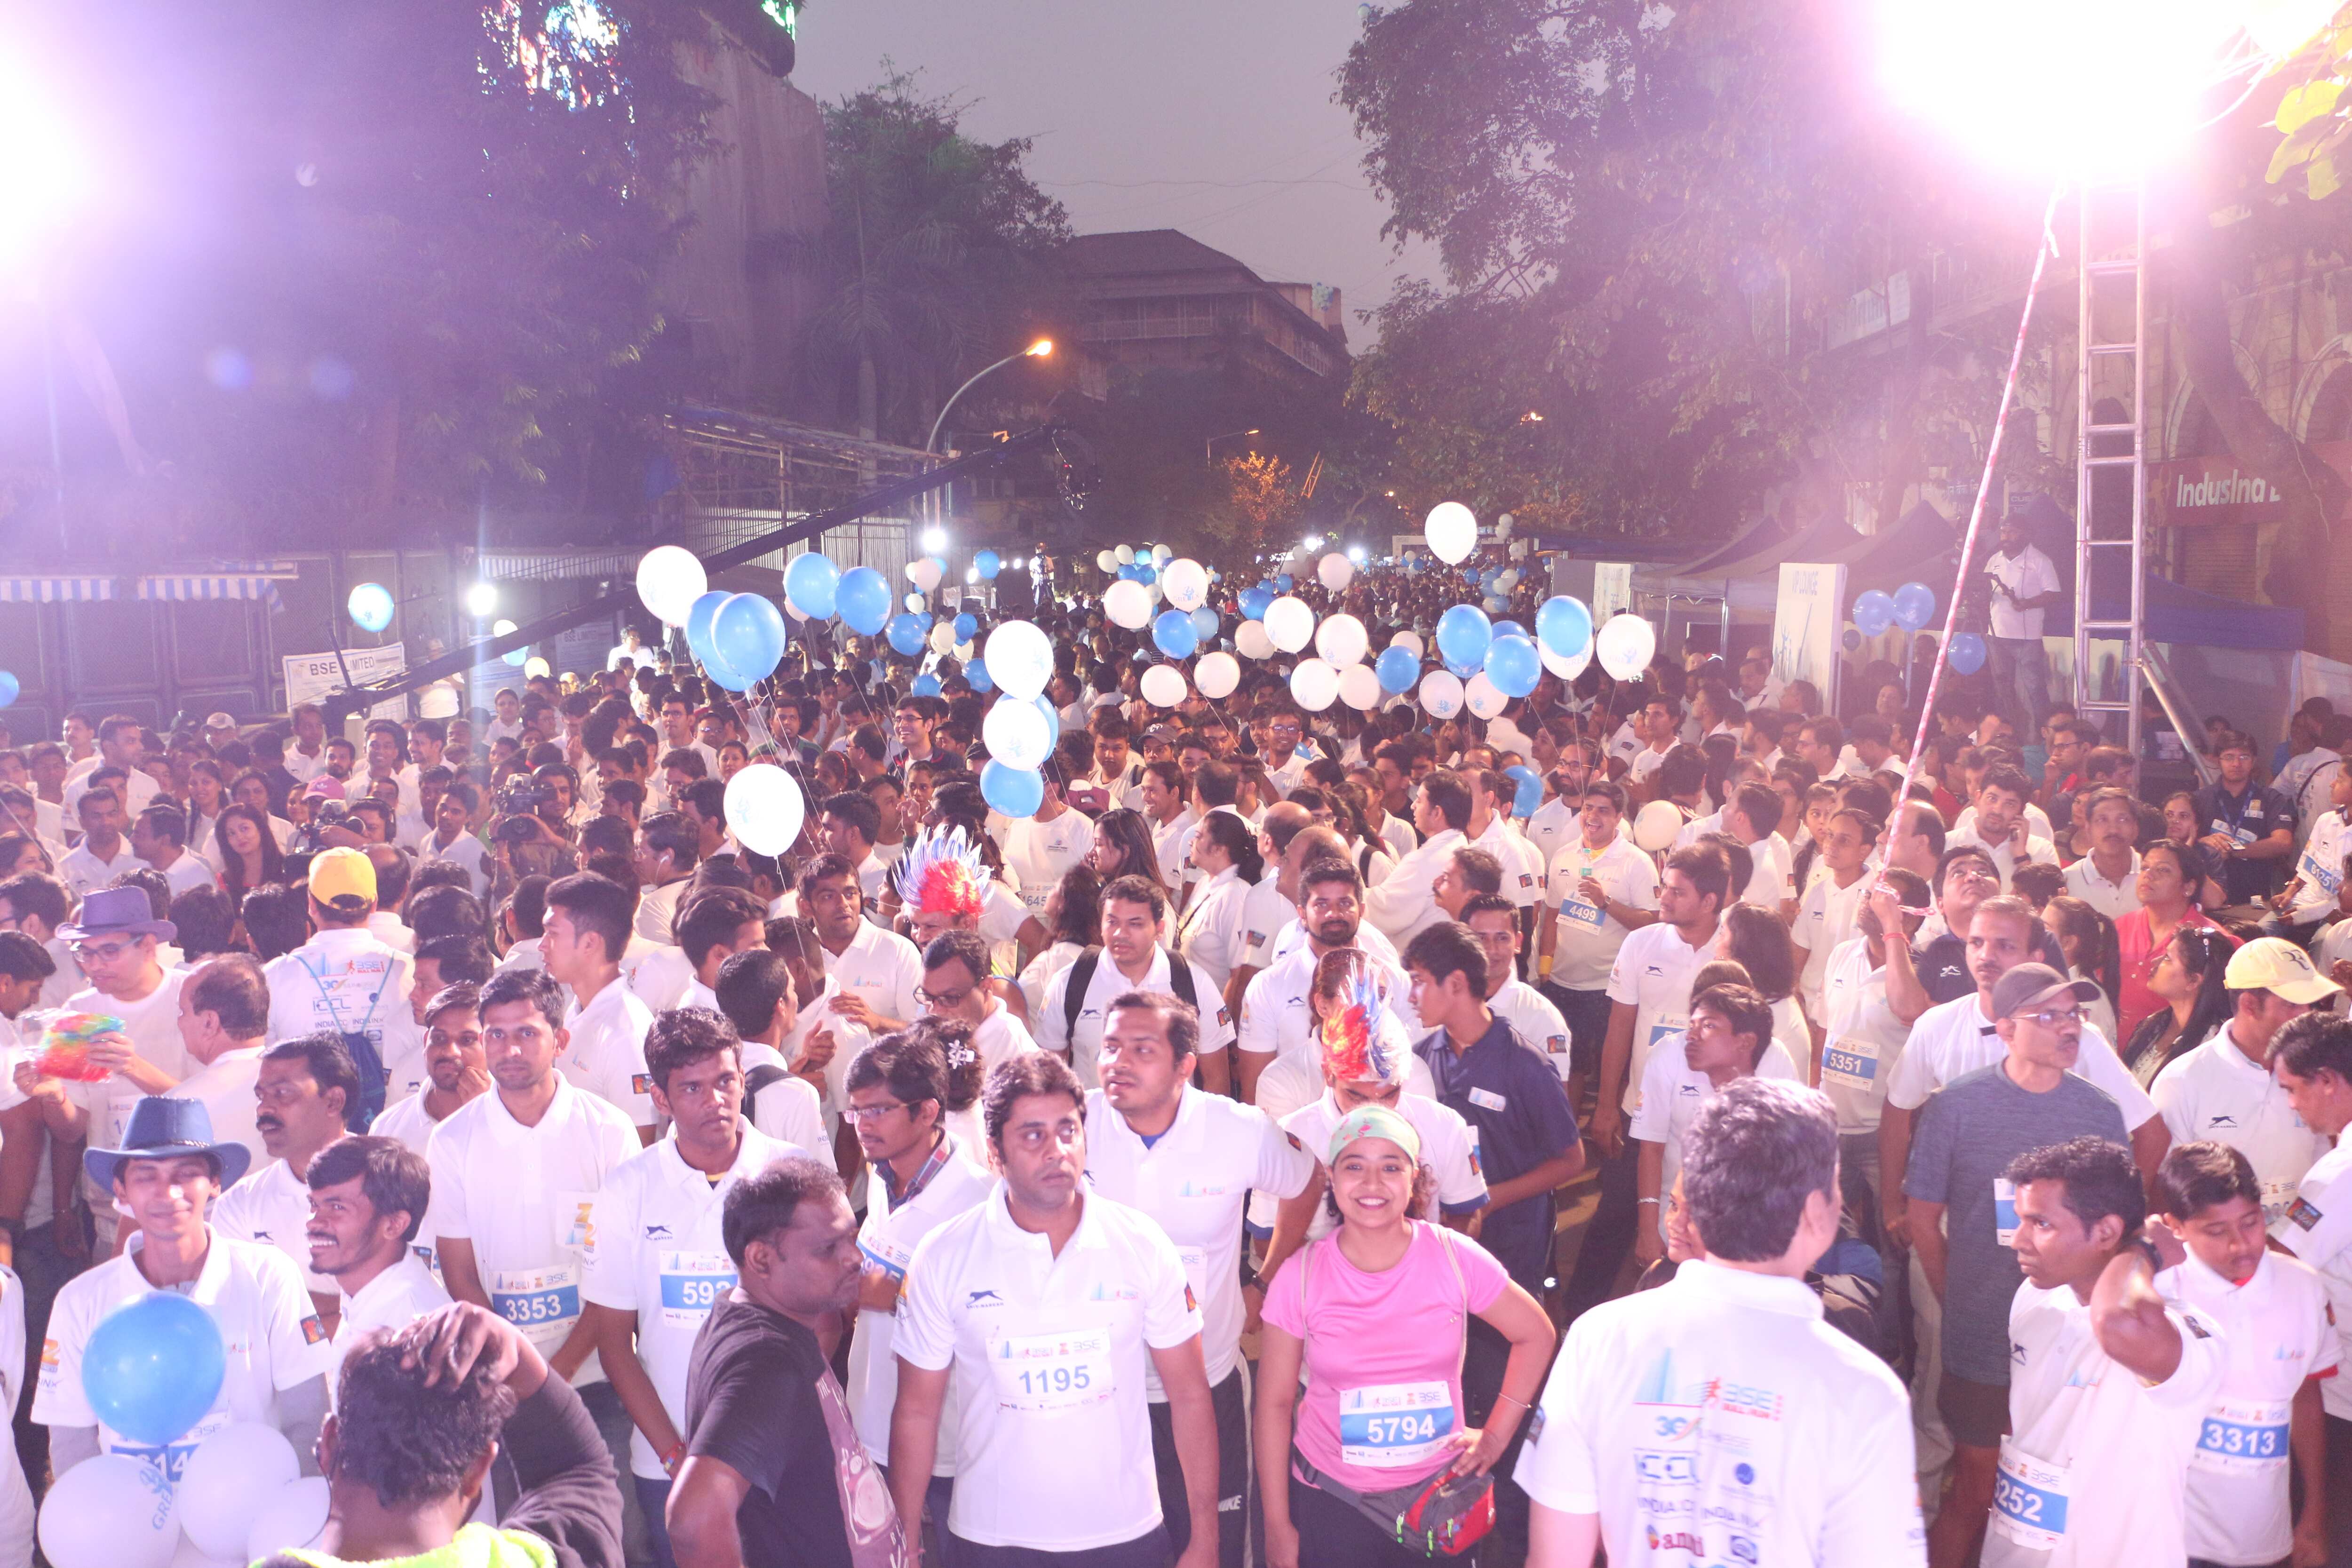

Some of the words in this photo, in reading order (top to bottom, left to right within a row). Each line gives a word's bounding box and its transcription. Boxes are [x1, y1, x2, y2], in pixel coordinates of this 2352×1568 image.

[310, 661, 338, 676] BSE
[346, 657, 375, 672] IMITED
[2311, 864, 2331, 886] 6125
[1569, 905, 1596, 921] 4499
[1829, 1052, 1861, 1073] 5351
[506, 1295, 561, 1321] 3353
[1019, 1365, 1090, 1394] 1195
[1367, 1414, 1436, 1443] 5794
[2205, 1424, 2275, 1455] 3313
